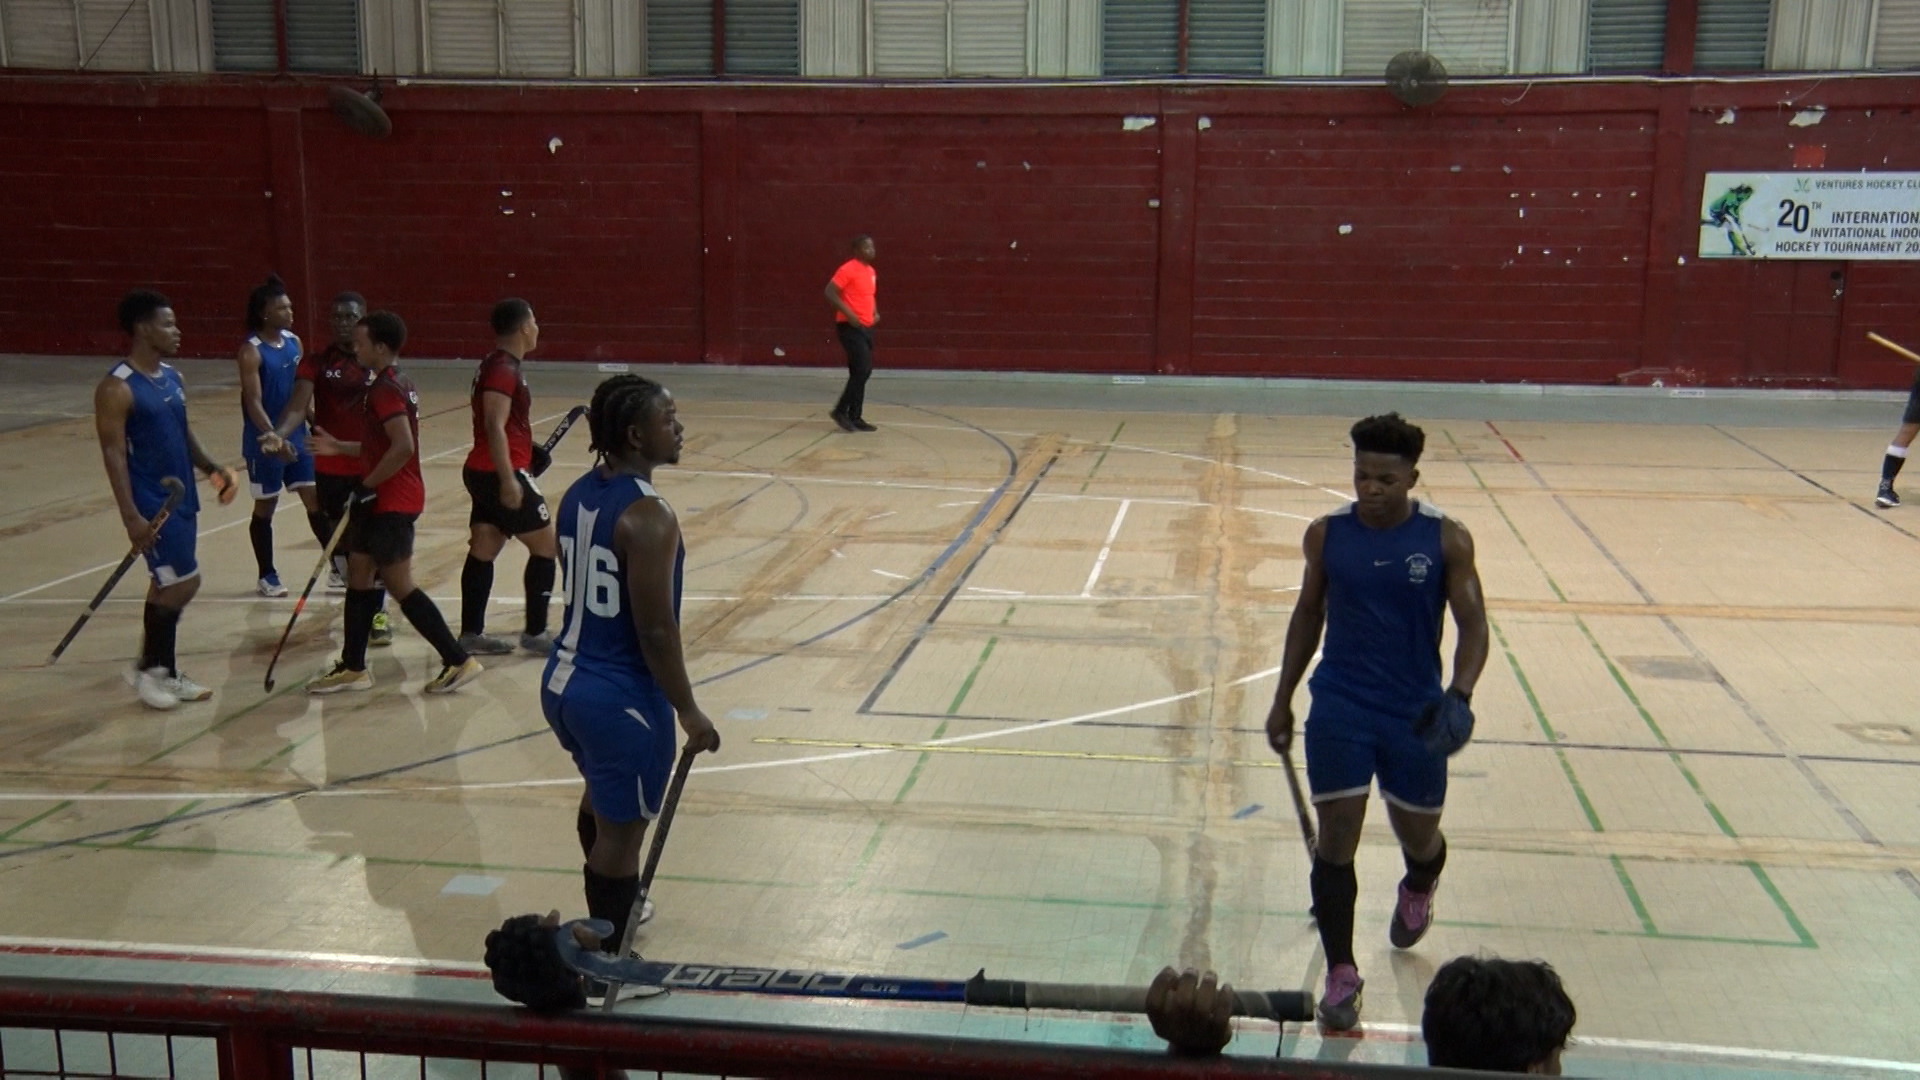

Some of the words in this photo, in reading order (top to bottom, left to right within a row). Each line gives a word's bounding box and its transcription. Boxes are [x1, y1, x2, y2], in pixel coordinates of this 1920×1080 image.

[1815, 179, 1864, 189] VENTURES
[1866, 179, 1905, 189] HOCKEY
[1907, 179, 1920, 189] CL
[1831, 211, 1920, 224] INTERNATION
[1810, 227, 1886, 238] INVITATIONAL
[1891, 227, 1920, 238] INDO
[1775, 241, 1820, 252] HOCKEY
[1823, 241, 1902, 253] TOURNAMENT
[1905, 241, 1920, 253] 20
